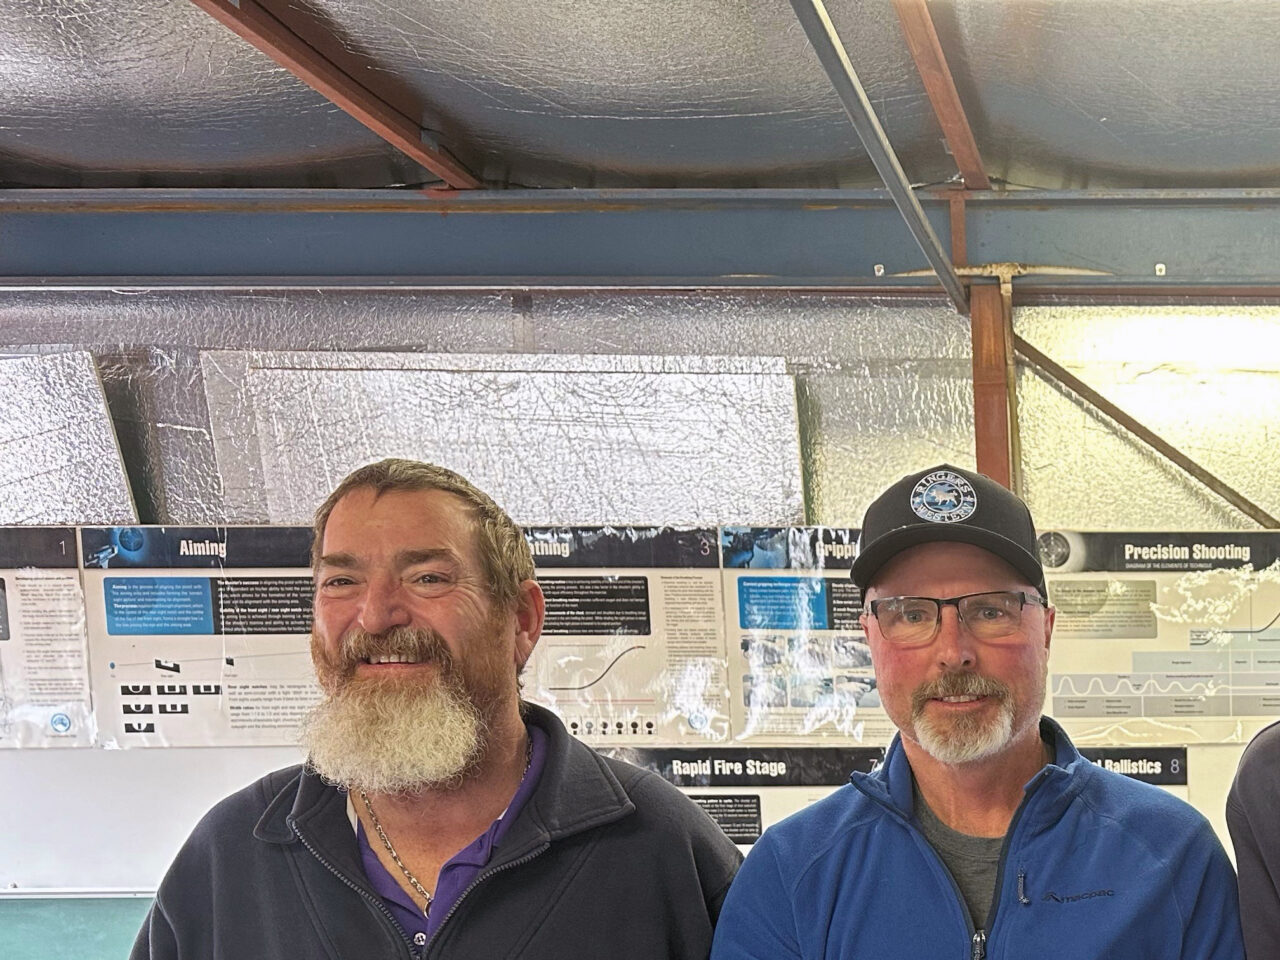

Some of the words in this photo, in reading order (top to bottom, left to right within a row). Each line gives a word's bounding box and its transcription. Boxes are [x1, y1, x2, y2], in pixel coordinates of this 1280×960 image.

[916, 472, 971, 494] RINGERS
[917, 503, 973, 522] WESTERN
[180, 540, 226, 558] Aiming
[531, 540, 570, 557] athing
[701, 539, 710, 556] 3
[1125, 544, 1189, 560] Precision
[1192, 544, 1250, 561] Shooting
[672, 760, 711, 777] Rapid
[714, 760, 743, 775] Fire
[746, 759, 786, 777] Stage
[1104, 759, 1162, 774] Ballistics
[1171, 759, 1180, 774] 8
